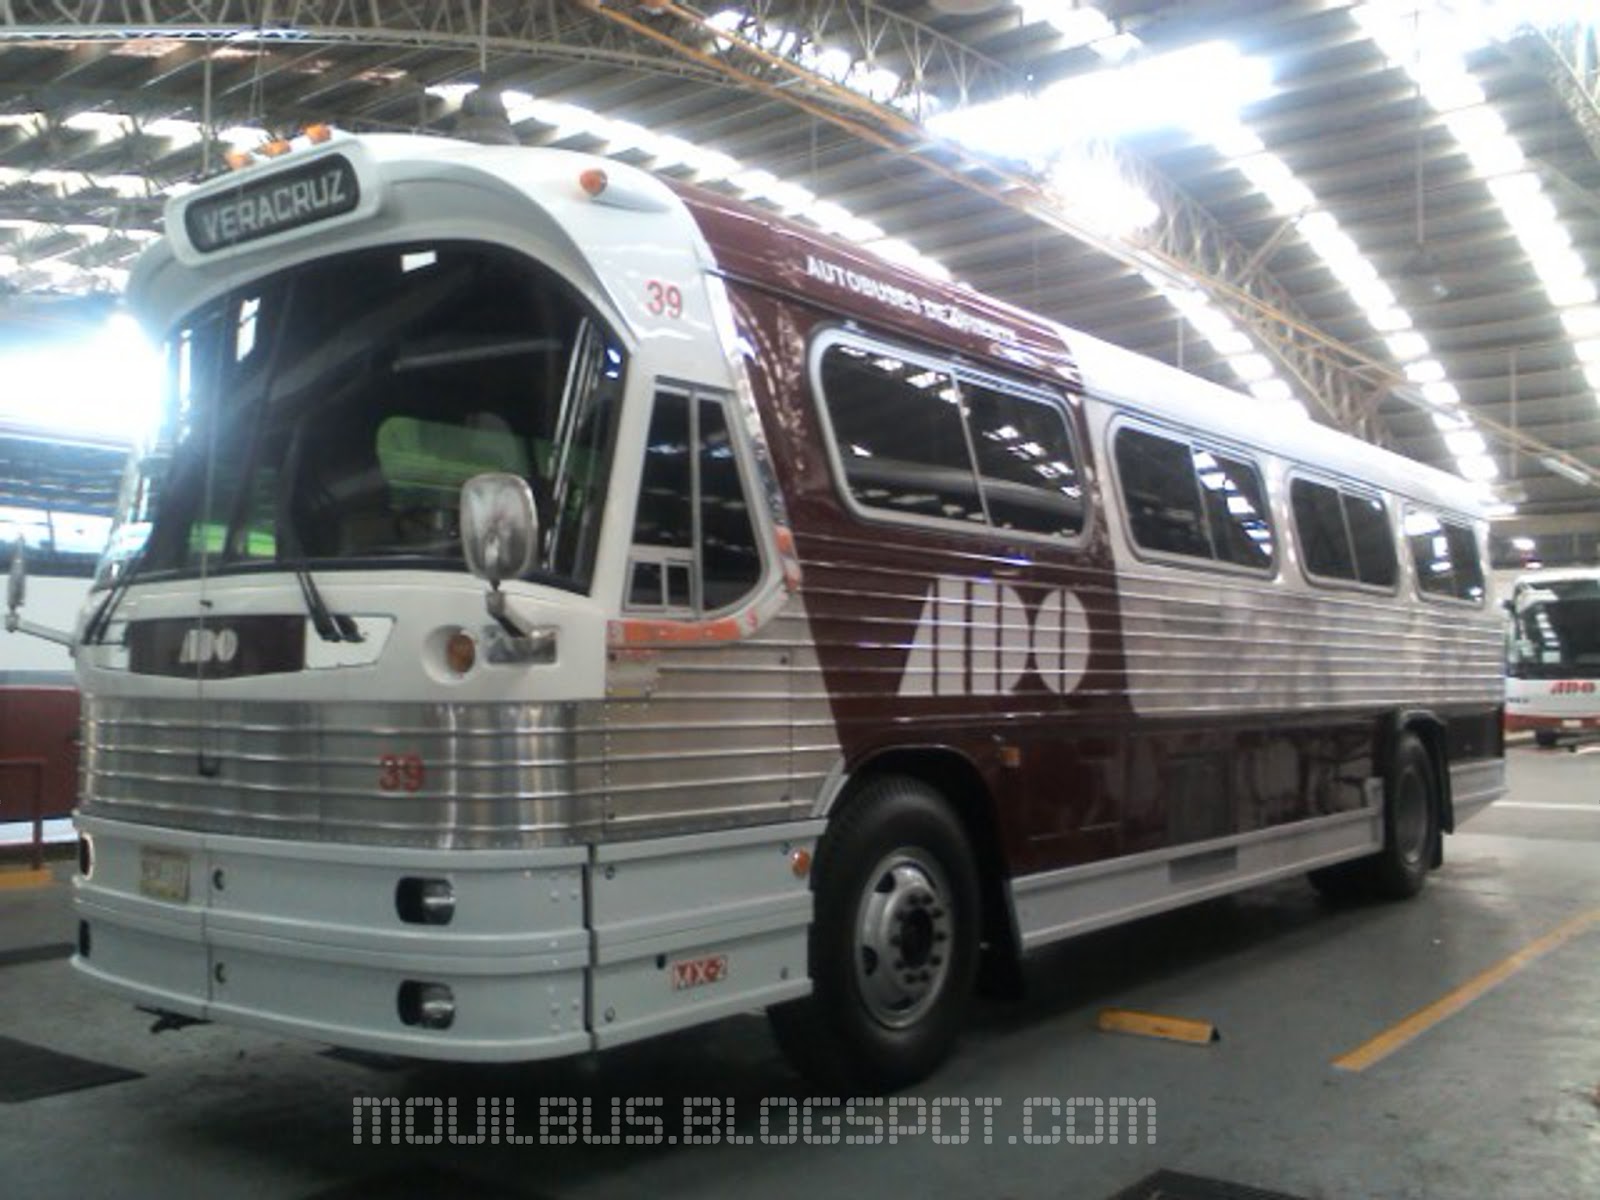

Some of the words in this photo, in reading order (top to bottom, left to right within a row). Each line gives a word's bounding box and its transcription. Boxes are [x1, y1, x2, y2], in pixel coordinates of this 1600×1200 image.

[202, 169, 346, 244] VERACRUZ
[646, 279, 683, 319] 39
[806, 256, 921, 314] AUTOBUSES
[179, 629, 239, 664] ADO
[897, 574, 1091, 698] ADO
[379, 753, 423, 792] 39
